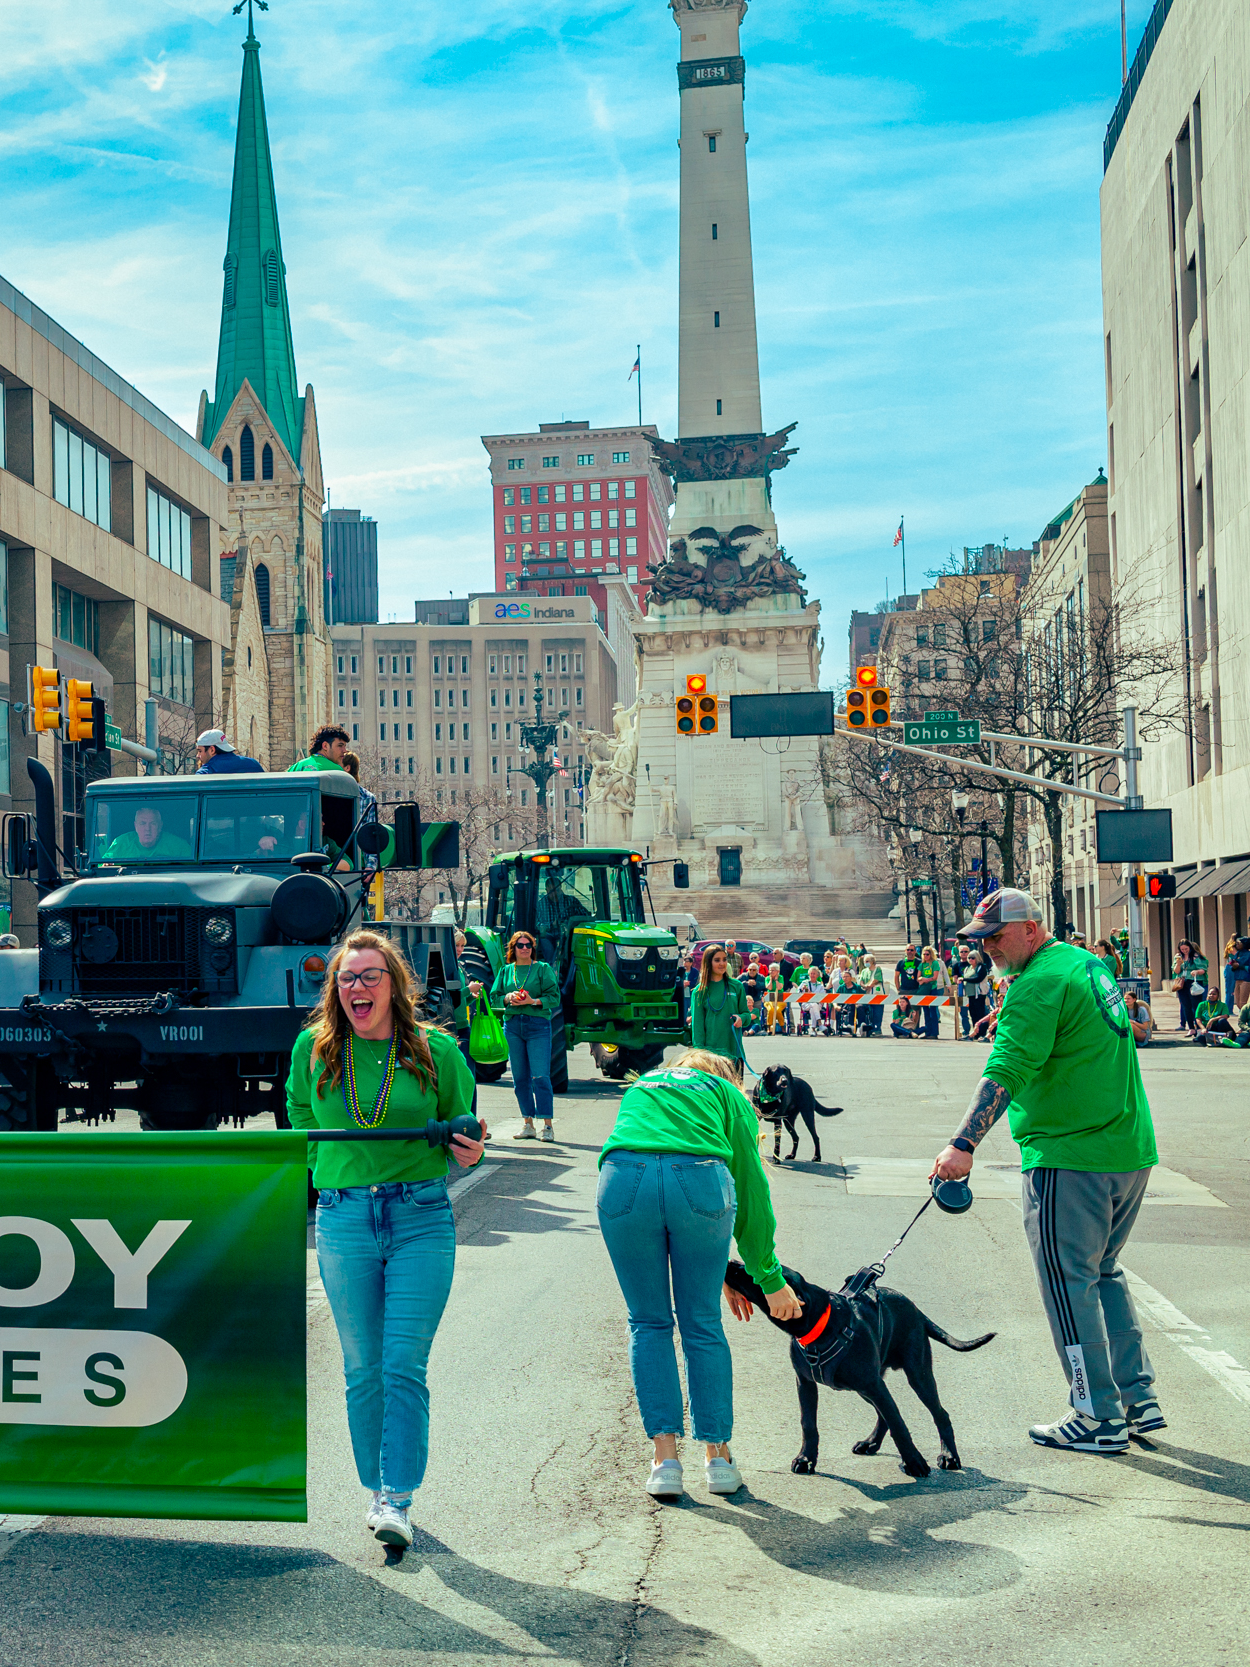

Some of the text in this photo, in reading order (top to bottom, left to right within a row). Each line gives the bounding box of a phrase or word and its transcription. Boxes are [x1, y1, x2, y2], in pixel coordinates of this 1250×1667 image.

[699, 68, 722, 78] 1865
[495, 603, 575, 619] aes Indiana
[909, 726, 975, 739] Ohio St
[160, 1025, 204, 1041] VR001
[1075, 1368, 1086, 1400] adidas
